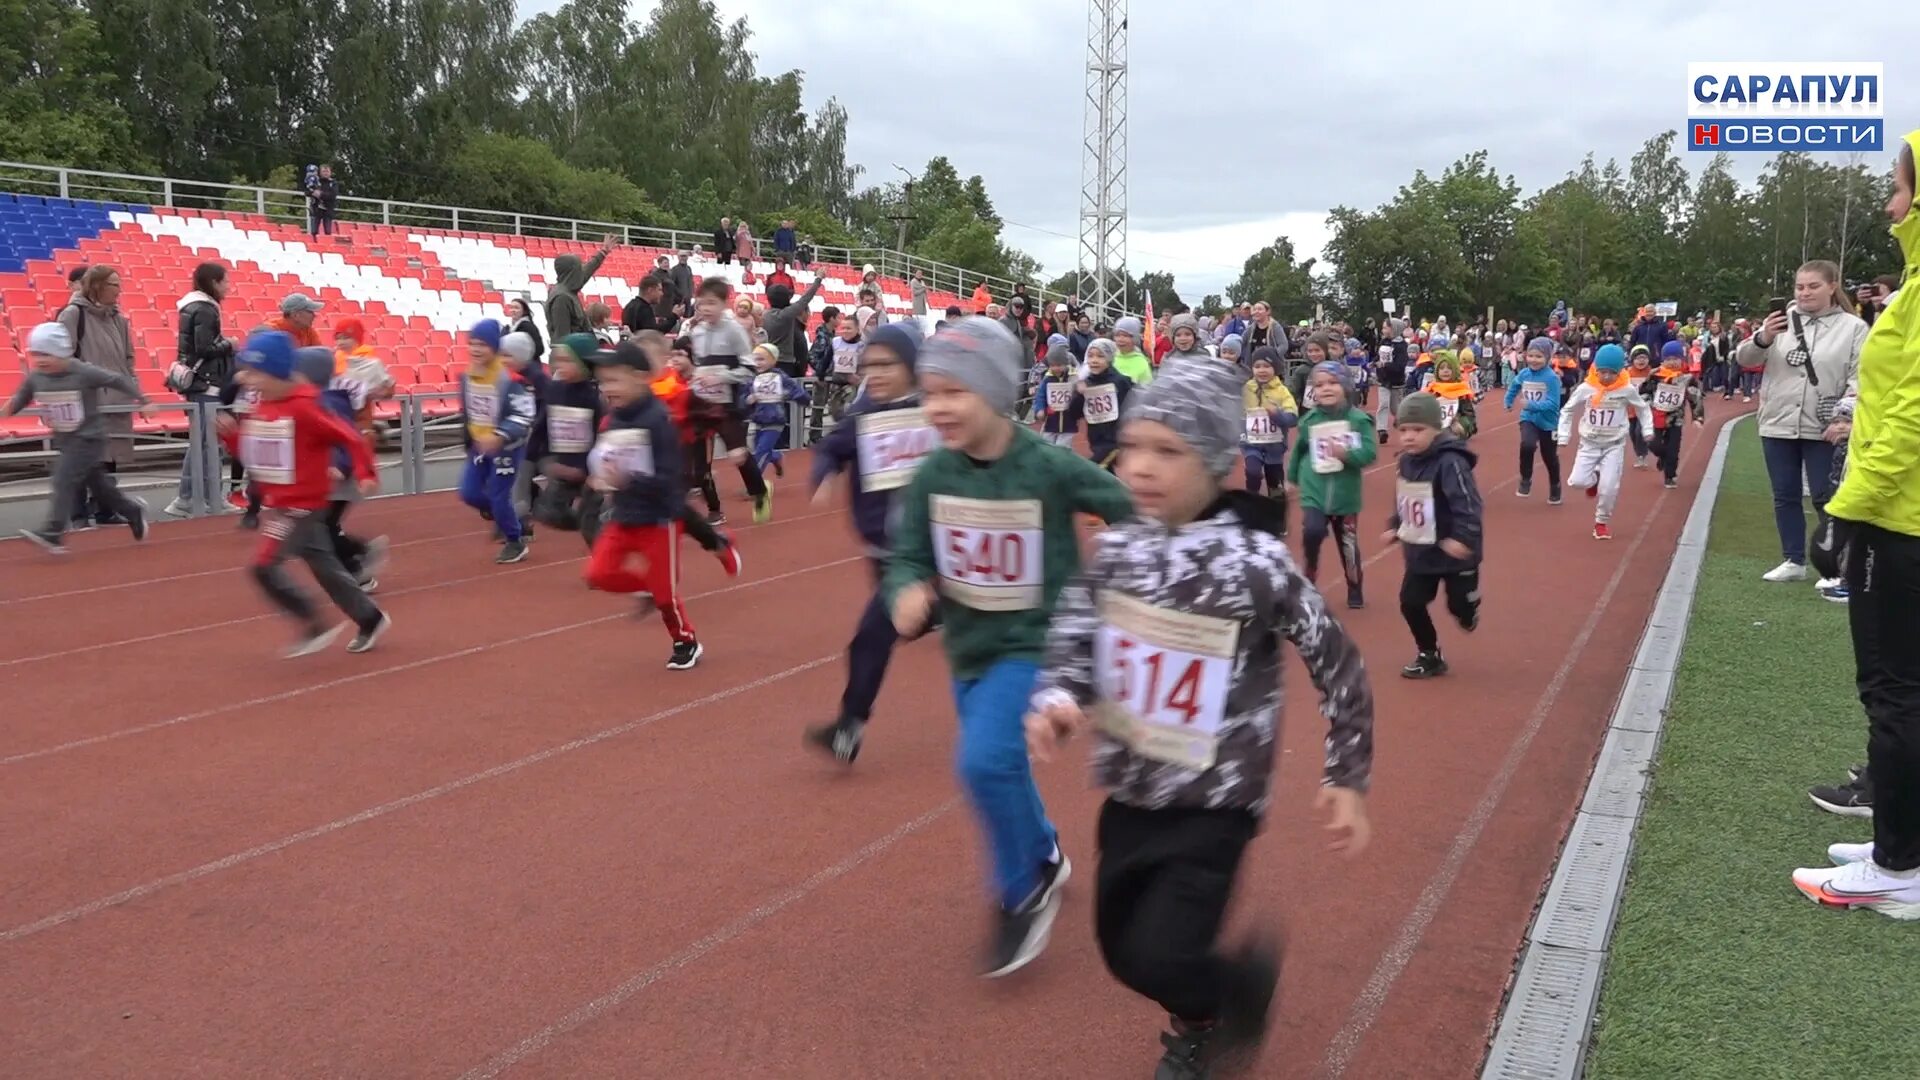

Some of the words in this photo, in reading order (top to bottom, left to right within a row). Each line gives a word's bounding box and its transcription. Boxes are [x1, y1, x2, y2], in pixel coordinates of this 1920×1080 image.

[1050, 390, 1072, 405] 526
[1087, 394, 1113, 415] 563
[1658, 391, 1681, 406] 543
[1589, 409, 1615, 426] 617
[947, 527, 1026, 582] 540
[1112, 635, 1206, 724] 514
